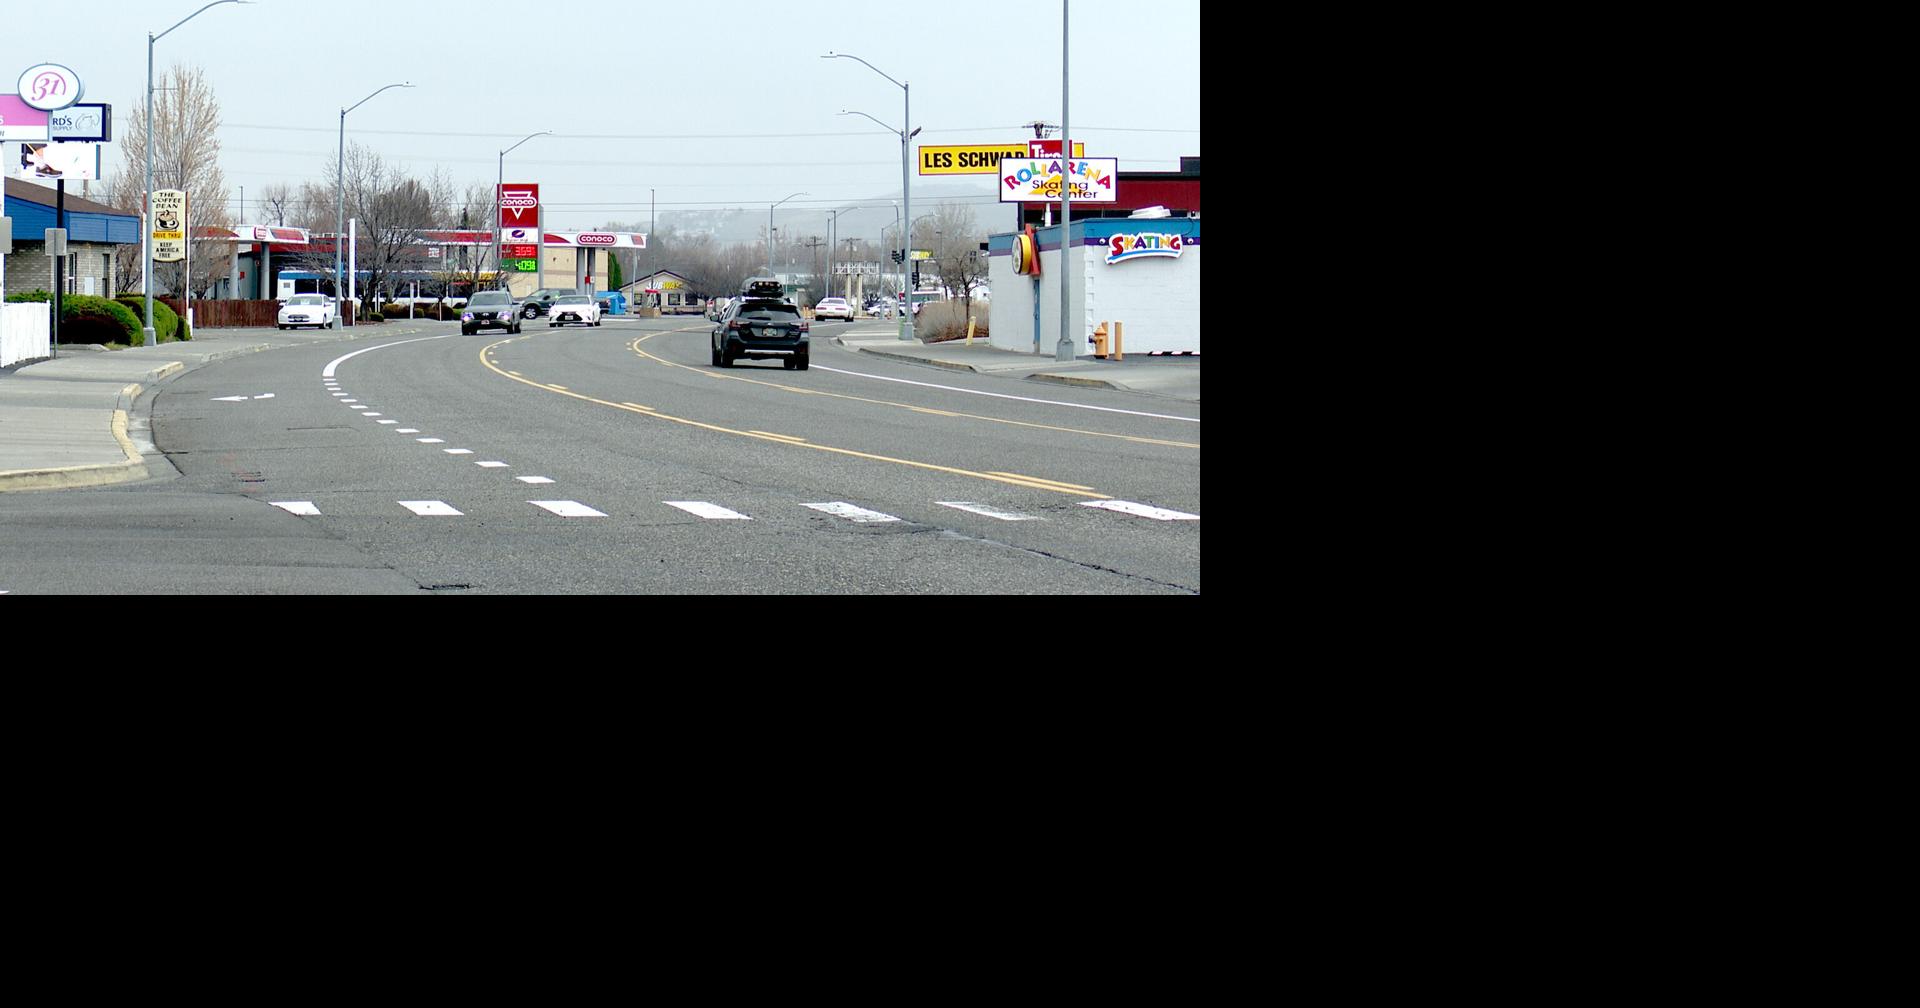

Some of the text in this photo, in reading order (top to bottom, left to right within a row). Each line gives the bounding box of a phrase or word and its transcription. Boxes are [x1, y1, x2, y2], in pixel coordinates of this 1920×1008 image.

[31, 78, 60, 101] 31
[925, 152, 953, 168] LES
[1003, 160, 1111, 190] ROLLARENA
[1032, 179, 1088, 191] Skatng
[580, 235, 614, 243] conoco
[1111, 235, 1180, 256] SKATING
